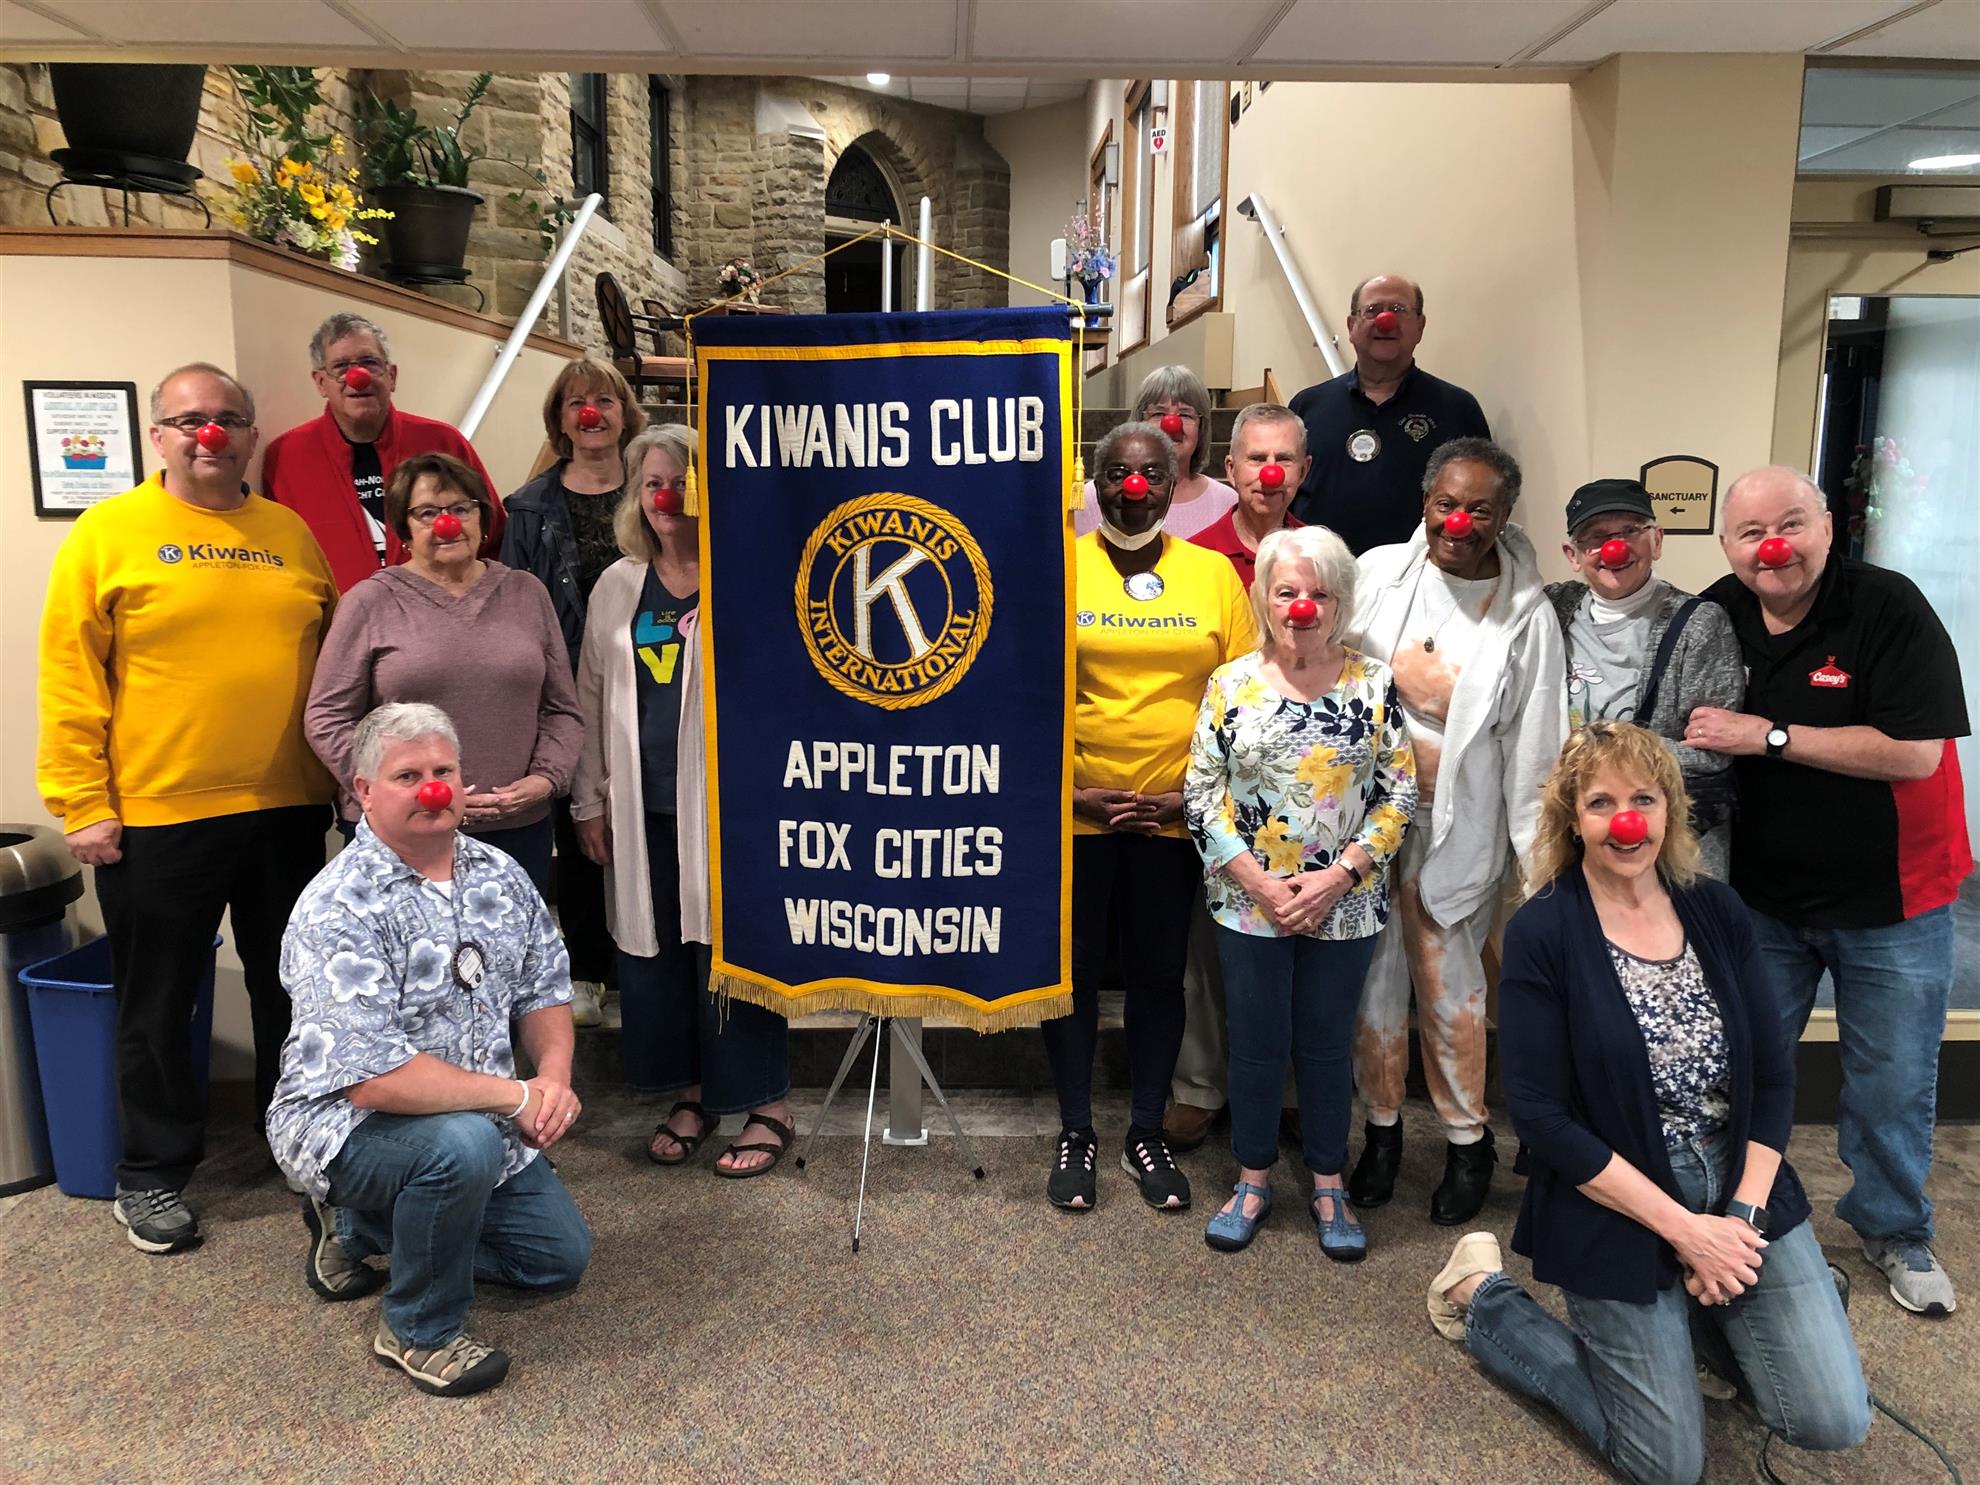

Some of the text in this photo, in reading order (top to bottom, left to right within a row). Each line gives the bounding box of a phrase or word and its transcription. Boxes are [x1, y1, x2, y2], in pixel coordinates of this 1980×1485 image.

[1152, 129, 1166, 137] AED
[726, 396, 1044, 468] KIWANIS CLUB
[1648, 492, 1708, 501] SANCTUARY
[188, 544, 284, 567] Kiwanis
[826, 511, 959, 560] KIWANIS
[850, 541, 935, 663] K
[1101, 612, 1197, 627] Kiwanis
[810, 599, 976, 691] INTERNATIONAL
[1813, 672, 1846, 684] Casey's
[783, 740, 1000, 796] APPLETON
[778, 820, 1003, 879] FOX CITIES
[784, 897, 1002, 956] WISCONSIN
